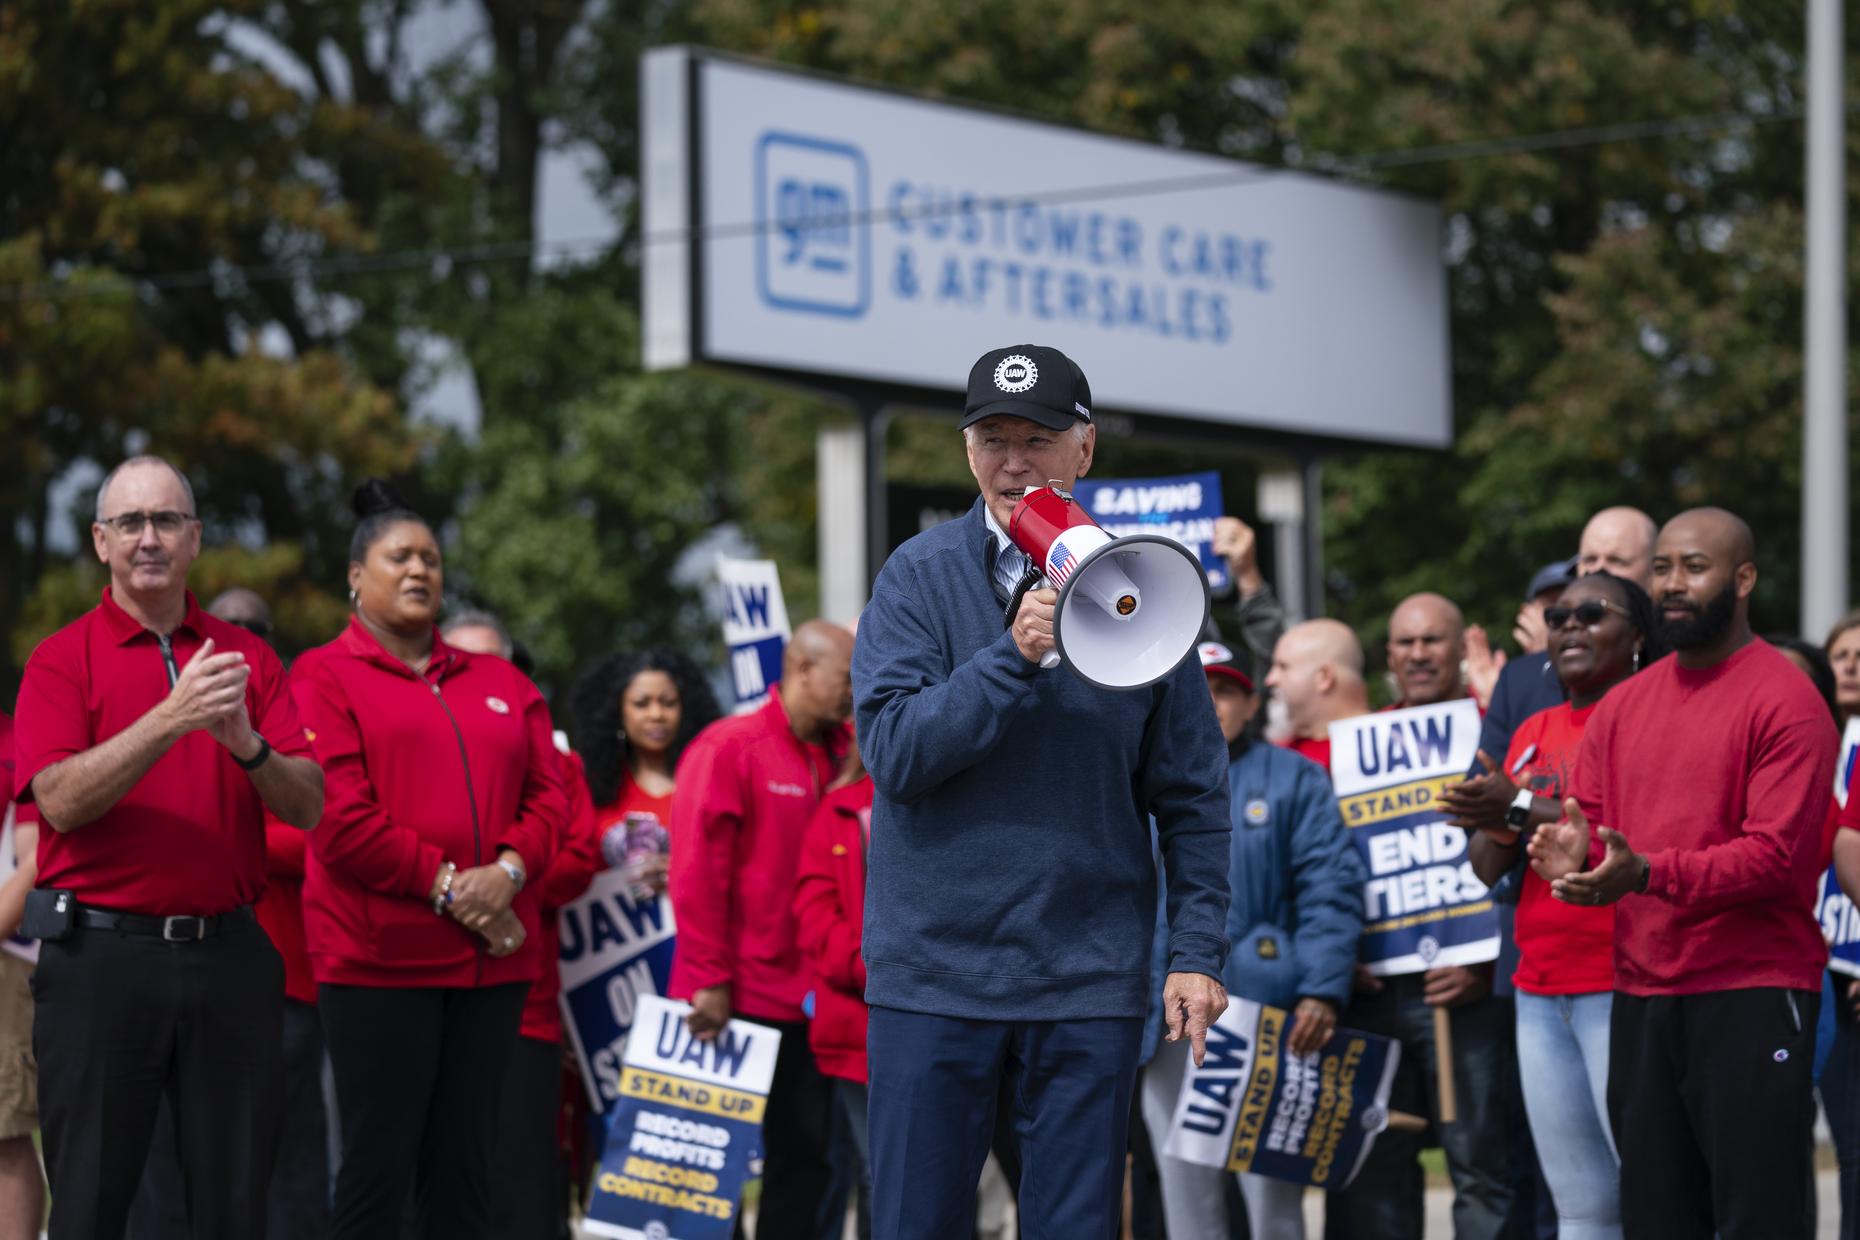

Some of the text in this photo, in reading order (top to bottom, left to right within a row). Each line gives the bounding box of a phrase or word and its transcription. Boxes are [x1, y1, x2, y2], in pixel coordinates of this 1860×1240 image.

[890, 182, 1274, 292] CUSTOMER CARE
[891, 246, 1233, 346] & AFTERSALES
[1005, 368, 1026, 378] UAW
[1093, 482, 1203, 515] SAVING
[1357, 714, 1452, 777] UAW
[1349, 786, 1432, 820] STAND
[1367, 821, 1469, 877] END
[1363, 859, 1490, 922] TIERS
[656, 1011, 753, 1077] UAW
[630, 1075, 754, 1114] STAND UP
[1180, 1022, 1249, 1137] UAW
[1235, 1018, 1276, 1161] STAND UP
[1302, 1055, 1341, 1158] RECORD
[634, 1110, 731, 1149] RECORD
[1311, 1038, 1367, 1183] CONTRACTS
[623, 1155, 719, 1194] RECORD
[629, 1130, 727, 1171] PROFITS
[597, 1171, 734, 1220] CONTRACTS
